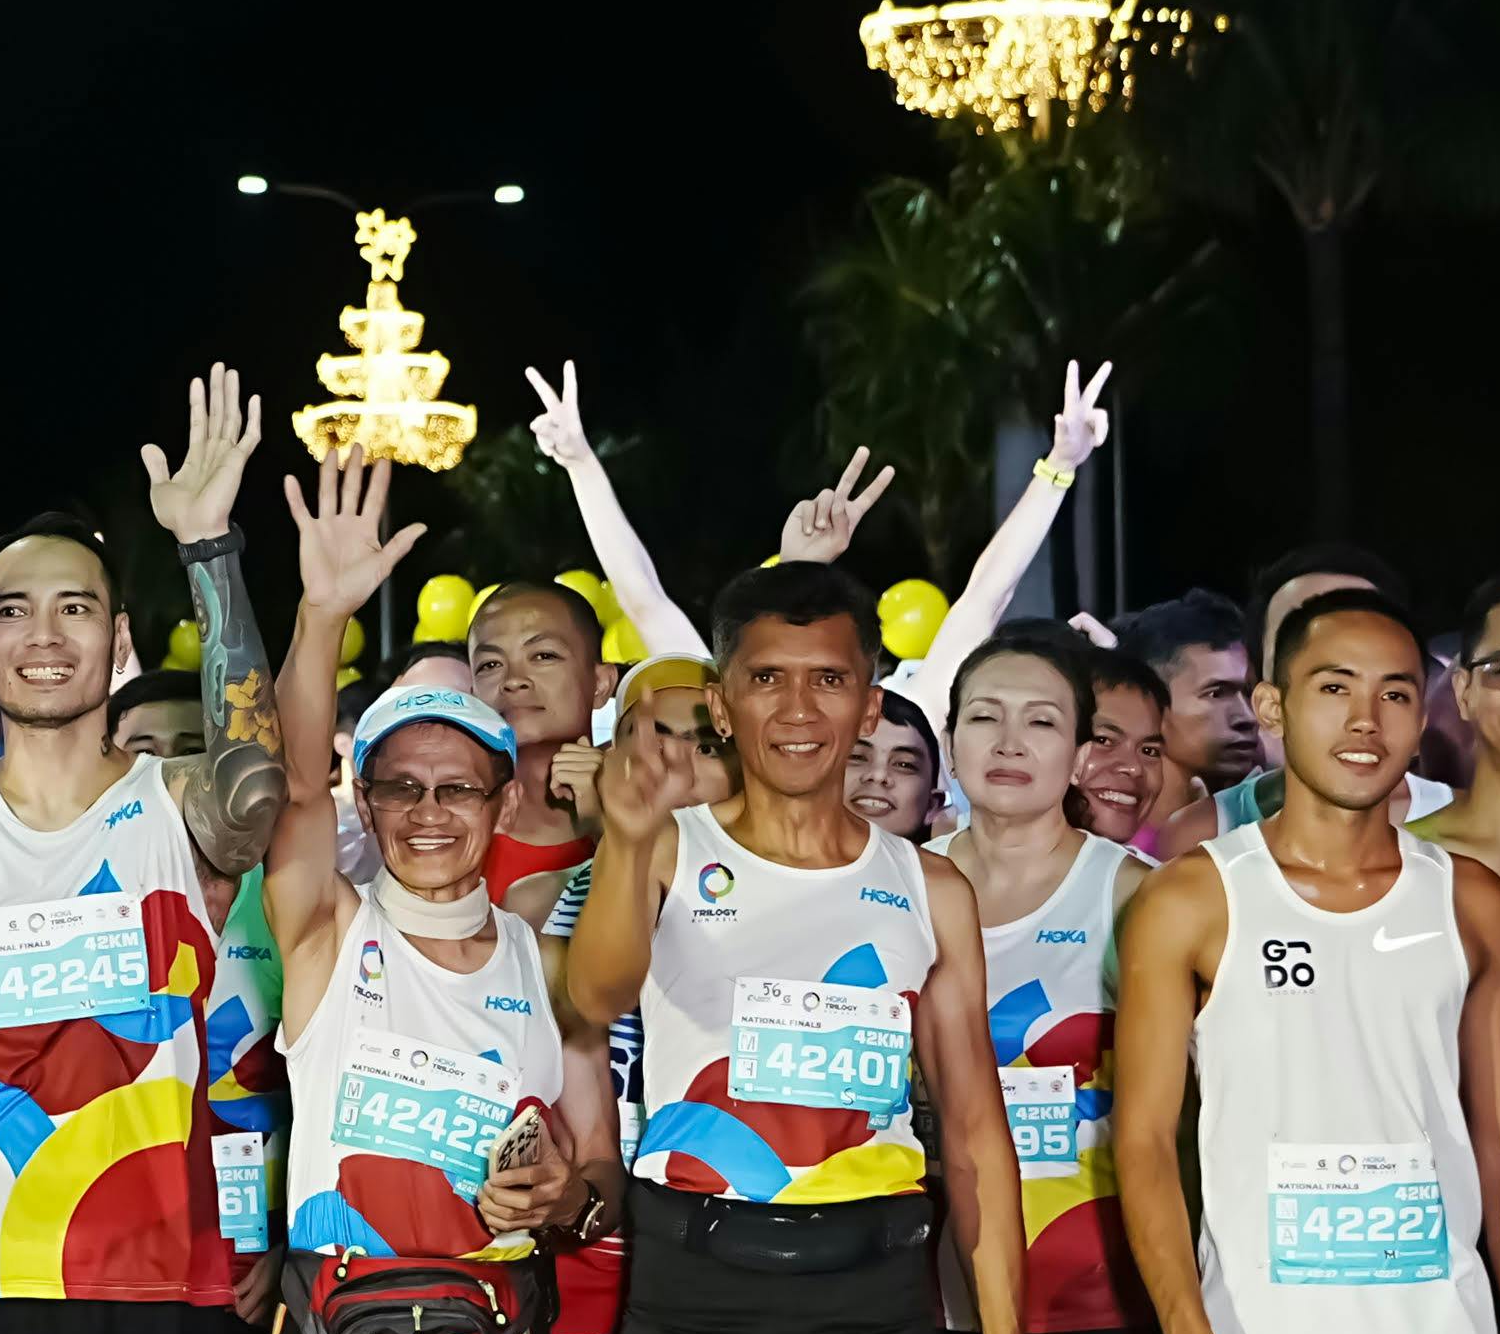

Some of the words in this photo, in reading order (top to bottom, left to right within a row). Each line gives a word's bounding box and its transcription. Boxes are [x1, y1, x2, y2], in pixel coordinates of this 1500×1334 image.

[860, 887, 911, 912] HOKA
[692, 909, 738, 918] TRILOGY
[19, 940, 51, 949] FINALS
[84, 932, 139, 951] 42KM
[1036, 930, 1087, 944] HOKA
[227, 946, 273, 961] HOKA
[0, 952, 146, 1001] 42245
[763, 982, 781, 998] 56
[485, 995, 532, 1016] HOKA
[825, 1002, 857, 1012] TRILOGY
[741, 1016, 787, 1026] NATIONAL
[789, 1019, 822, 1028] FINALS
[854, 1029, 904, 1049] 42KM
[351, 1064, 393, 1078] NATIONAL
[394, 1072, 426, 1086] FINALS
[433, 1063, 466, 1078] TRILOGY
[766, 1042, 900, 1089] 42401
[455, 1095, 508, 1123] 42KM
[1016, 1106, 1070, 1120] 42KM
[361, 1092, 505, 1157] 42422
[1303, 1206, 1443, 1242] 42227
